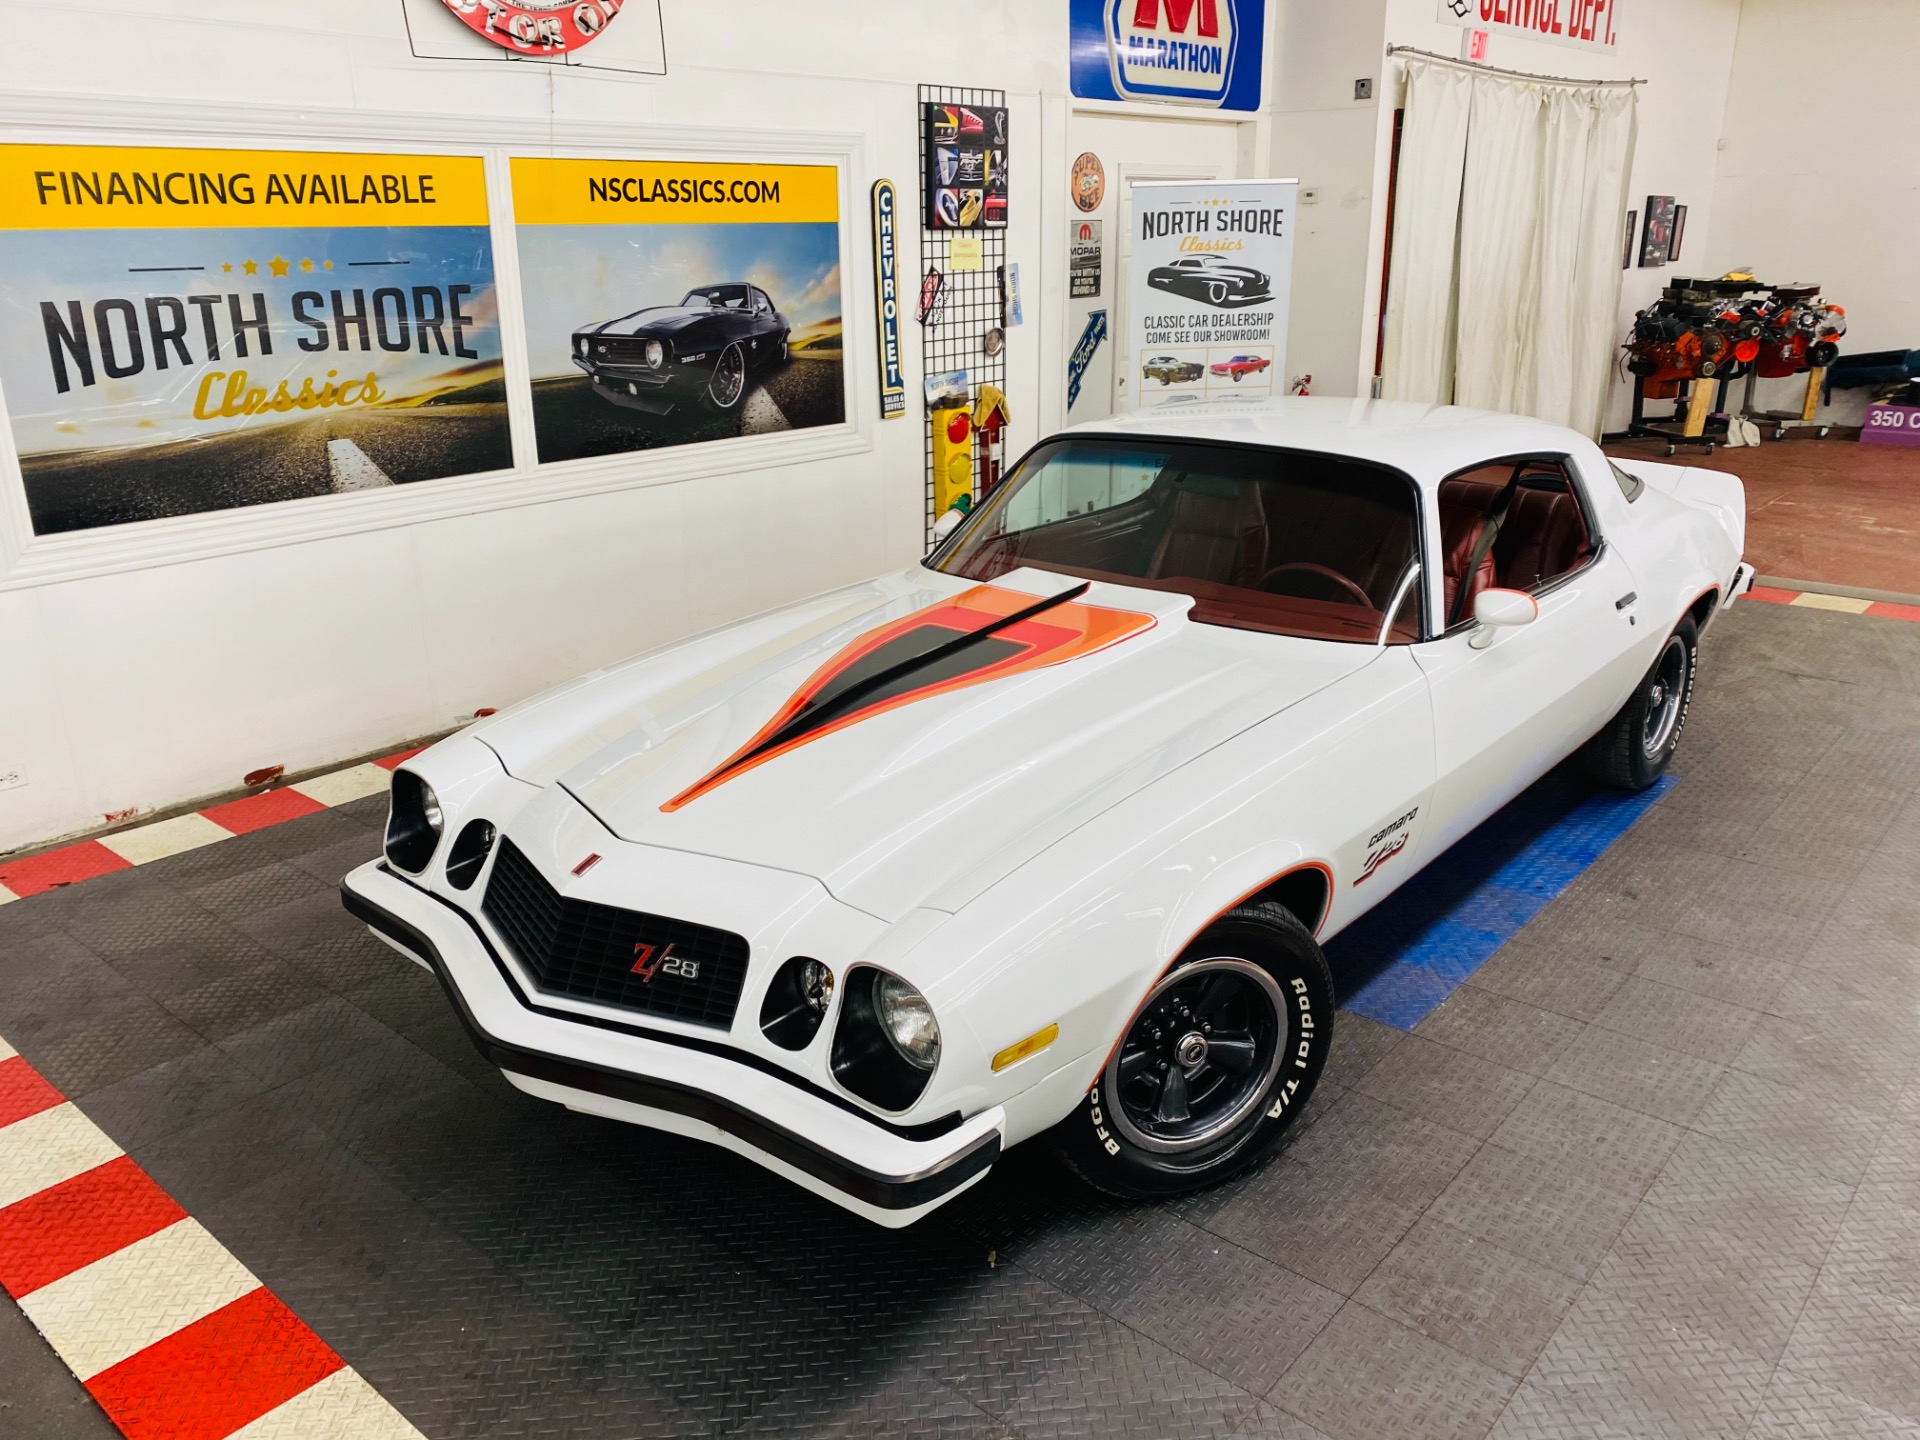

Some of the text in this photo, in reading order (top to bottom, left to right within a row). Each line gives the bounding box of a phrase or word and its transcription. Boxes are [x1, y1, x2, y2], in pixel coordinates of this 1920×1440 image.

[1127, 35, 1222, 74] MARATHON
[34, 171, 436, 206] FINANCING AVAILABLE
[589, 177, 780, 204] NSCLASSICS.COM
[1142, 208, 1284, 241] NORTH SHORE
[1179, 235, 1244, 252] Classics
[1070, 246, 1101, 255] MOPAR
[880, 191, 898, 383] CHEVROLET
[40, 284, 478, 394] NORTH SHORE
[1144, 312, 1274, 329] CLASSIC CAR DEALERSHIP
[1146, 328, 1270, 344] COME SEE OUR SHOWROOM!
[1075, 331, 1096, 373] Ford
[193, 368, 385, 421] Classics
[1871, 410, 1904, 428] 350
[1368, 806, 1419, 849] camaro
[630, 942, 700, 983] Z/28
[1266, 977, 1315, 1119] Radial T/A
[1090, 1079, 1121, 1156] BFGo
